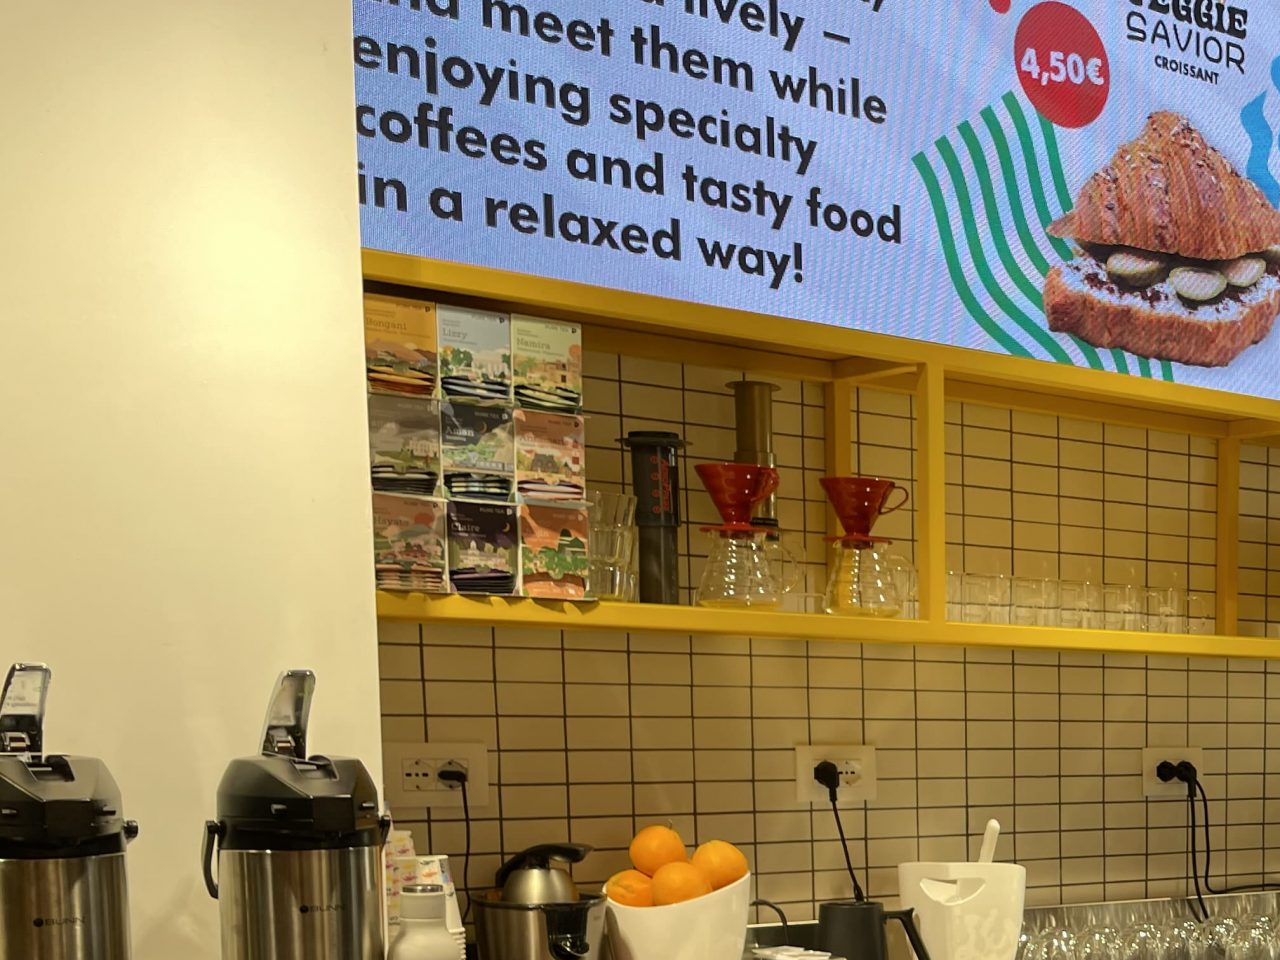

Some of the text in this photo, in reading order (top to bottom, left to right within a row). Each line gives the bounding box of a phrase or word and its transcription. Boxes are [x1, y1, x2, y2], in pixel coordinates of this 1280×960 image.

[482, 0, 886, 124] meet them while
[1021, 48, 1104, 85] 4,50€
[1127, 11, 1245, 74] SAVIOR
[1155, 55, 1219, 85] CROISSANT
[354, 35, 817, 175] enjoying specialty
[356, 102, 901, 243] coffees and tasty food
[358, 162, 803, 289] in a relaxed way!
